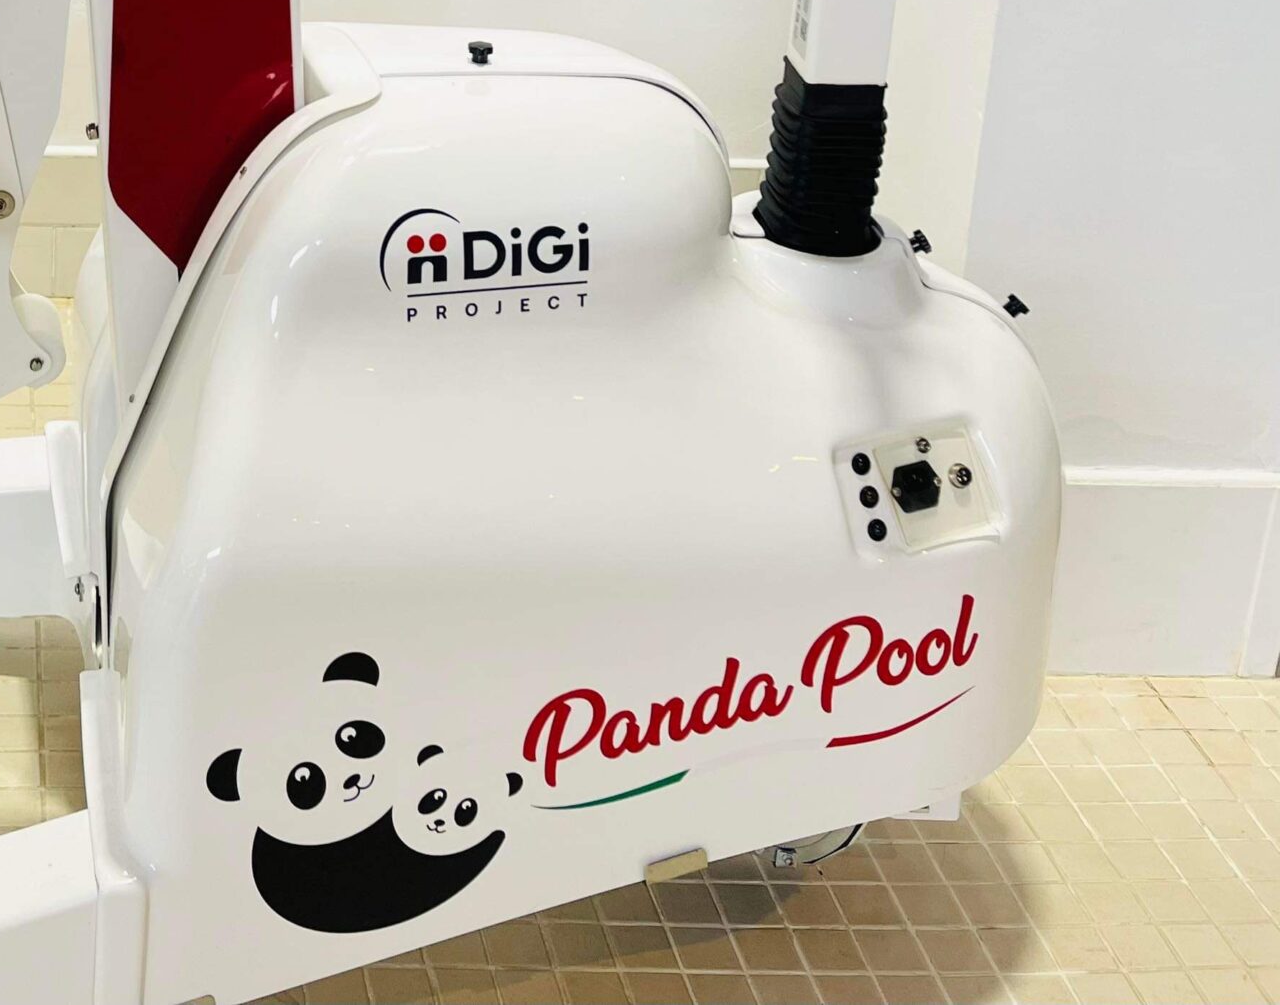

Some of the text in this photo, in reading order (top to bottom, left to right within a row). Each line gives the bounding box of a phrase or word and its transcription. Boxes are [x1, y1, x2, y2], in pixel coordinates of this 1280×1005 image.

[462, 222, 590, 281] DiGi
[406, 292, 588, 323] PROJECT
[522, 594, 979, 787] Panda Pool
